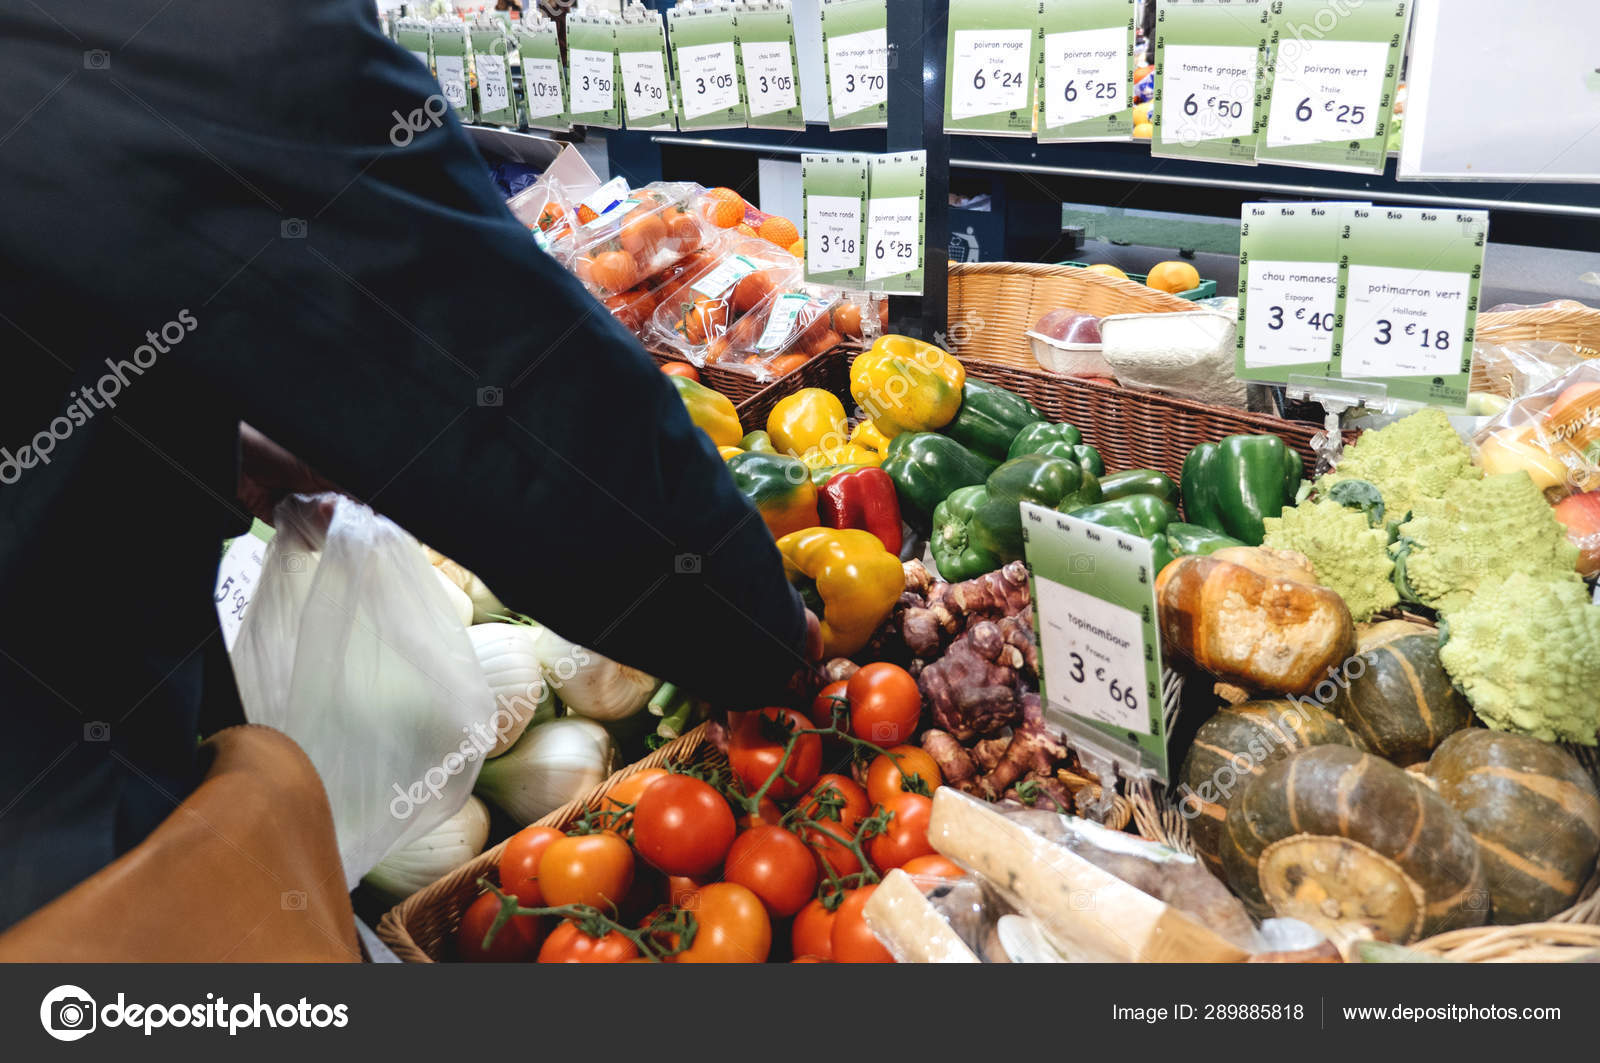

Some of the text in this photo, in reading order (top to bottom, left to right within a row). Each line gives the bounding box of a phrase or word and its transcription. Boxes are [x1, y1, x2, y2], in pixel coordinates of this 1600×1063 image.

[974, 42, 1024, 50] poivron rouge
[1064, 50, 1117, 60] poivron rouge
[1182, 64, 1247, 76] tomate grappe
[1304, 65, 1368, 76] poivron vert
[582, 76, 590, 91] 3
[696, 78, 706, 94] 3
[760, 76, 768, 93] 3
[846, 74, 855, 92] 3
[974, 68, 986, 90] 6
[634, 82, 642, 96] 4
[1064, 80, 1077, 102] 6
[1184, 93, 1198, 116] 6
[1295, 97, 1312, 122] 6
[819, 210, 837, 218] tomate
[897, 215, 912, 223] jaune
[1354, 210, 1473, 223] Bio Bio Bio Bio
[821, 235, 829, 253] 3
[876, 240, 884, 259] 6
[1262, 272, 1285, 281] chou
[1285, 293, 1314, 302] Espagne
[1333, 225, 1350, 356] Bio Bio Bio Bio Bio
[1368, 285, 1461, 300] potimarron vert
[1462, 232, 1484, 373] Bio Bio Bio Bio Bio
[1268, 306, 1284, 330] 3
[1392, 307, 1427, 317] Hollande
[1374, 319, 1392, 345] 3
[1029, 512, 1132, 552] Bio Bio Bio Bio
[216, 576, 234, 603] 5
[1068, 612, 1131, 649] topinambour
[1070, 652, 1085, 684] 3
